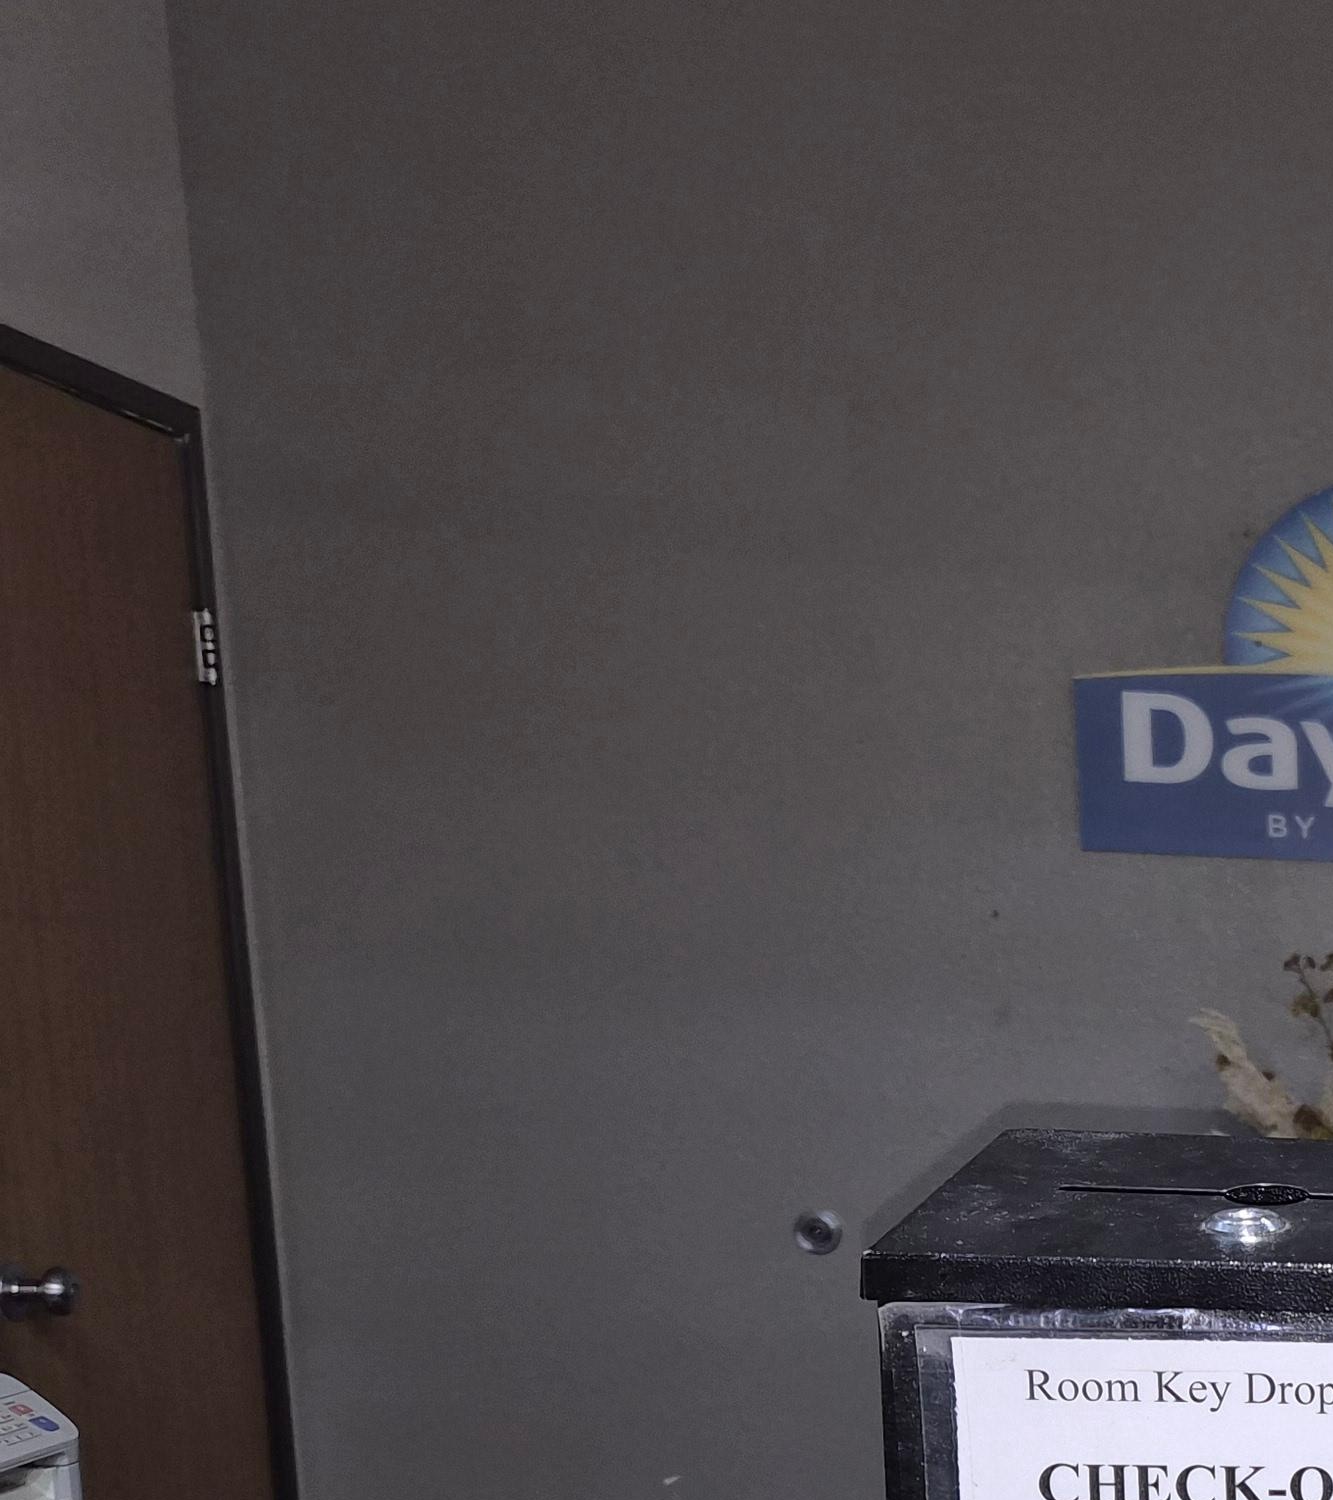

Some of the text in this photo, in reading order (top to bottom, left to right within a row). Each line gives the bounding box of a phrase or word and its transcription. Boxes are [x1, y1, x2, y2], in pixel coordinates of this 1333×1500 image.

[1267, 814, 1314, 839] BY
[1027, 1370, 1140, 1401] Room
[1154, 1371, 1230, 1412] Key
